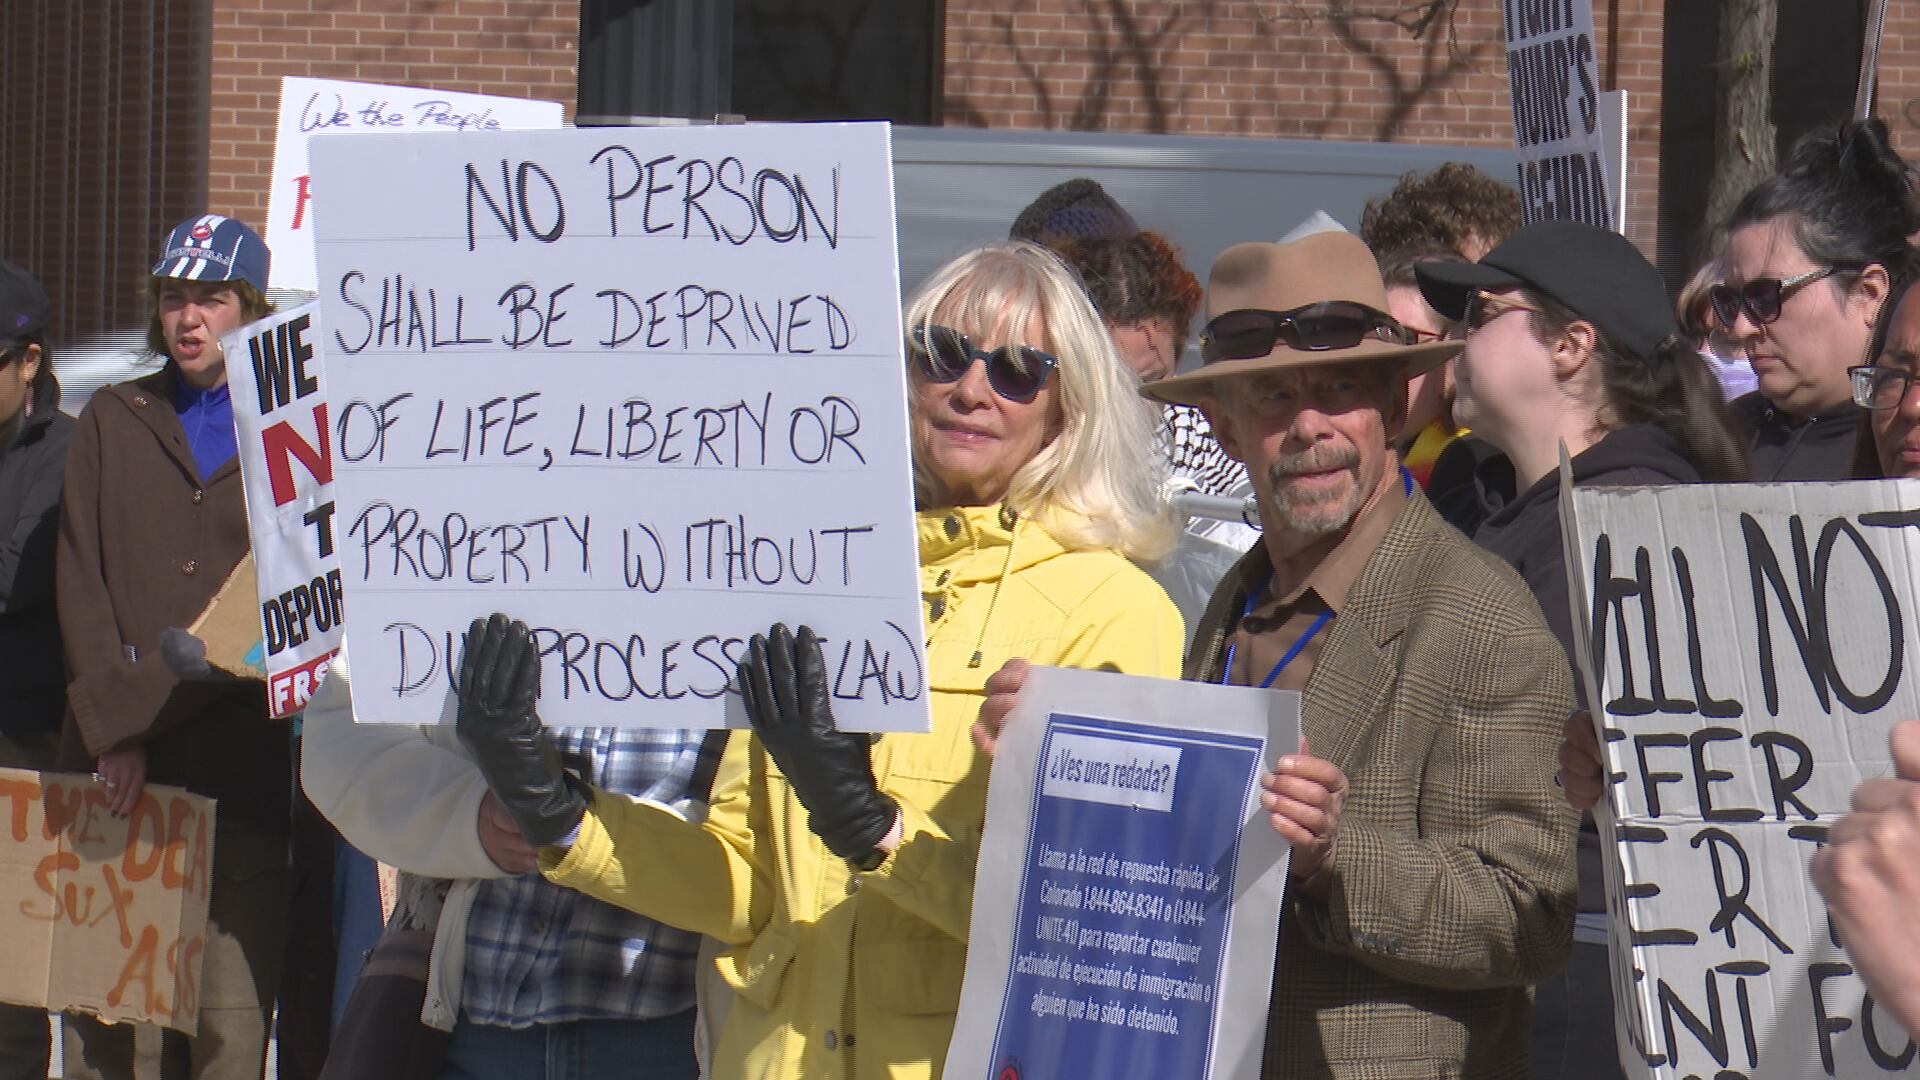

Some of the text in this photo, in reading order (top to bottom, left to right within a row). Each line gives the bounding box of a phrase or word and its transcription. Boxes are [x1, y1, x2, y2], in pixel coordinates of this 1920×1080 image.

[300, 92, 502, 132] We the People
[1507, 33, 1597, 148] RUMP'S
[465, 145, 840, 252] NO PERSON
[1517, 152, 1612, 228] GENDA
[335, 270, 857, 354] SHALL BE DEPRIVED
[248, 313, 318, 415] WE
[337, 391, 866, 471] OF LIFE, LIBERTY OR
[348, 501, 877, 594] PROPERTY WITHOUT
[1741, 507, 1920, 717] NO
[273, 655, 338, 714] FRS
[384, 620, 923, 705] DU PROCESS LAW
[1051, 748, 1171, 793] ¿Ves una redada?
[0, 780, 112, 842] THE
[1038, 843, 1068, 870] Llama
[1066, 853, 1075, 871] a
[1075, 848, 1087, 873] la
[1087, 851, 1106, 876] red
[1105, 852, 1120, 878] de
[1171, 862, 1203, 892] rápida
[1205, 864, 1220, 892] de
[1040, 879, 1082, 909] Colorado
[1164, 903, 1172, 922] o
[106, 924, 204, 1020] ASS
[1059, 955, 1073, 981] de
[1073, 959, 1121, 987] ejecución
[1122, 966, 1138, 991] de
[1138, 968, 1203, 1002] inmigración
[1204, 984, 1212, 1003] o
[1079, 927, 1102, 951] para
[1102, 930, 1150, 956] reportar
[1151, 935, 1201, 966] cualquier
[1031, 988, 1179, 1035] alguien que ha sido detenido.
